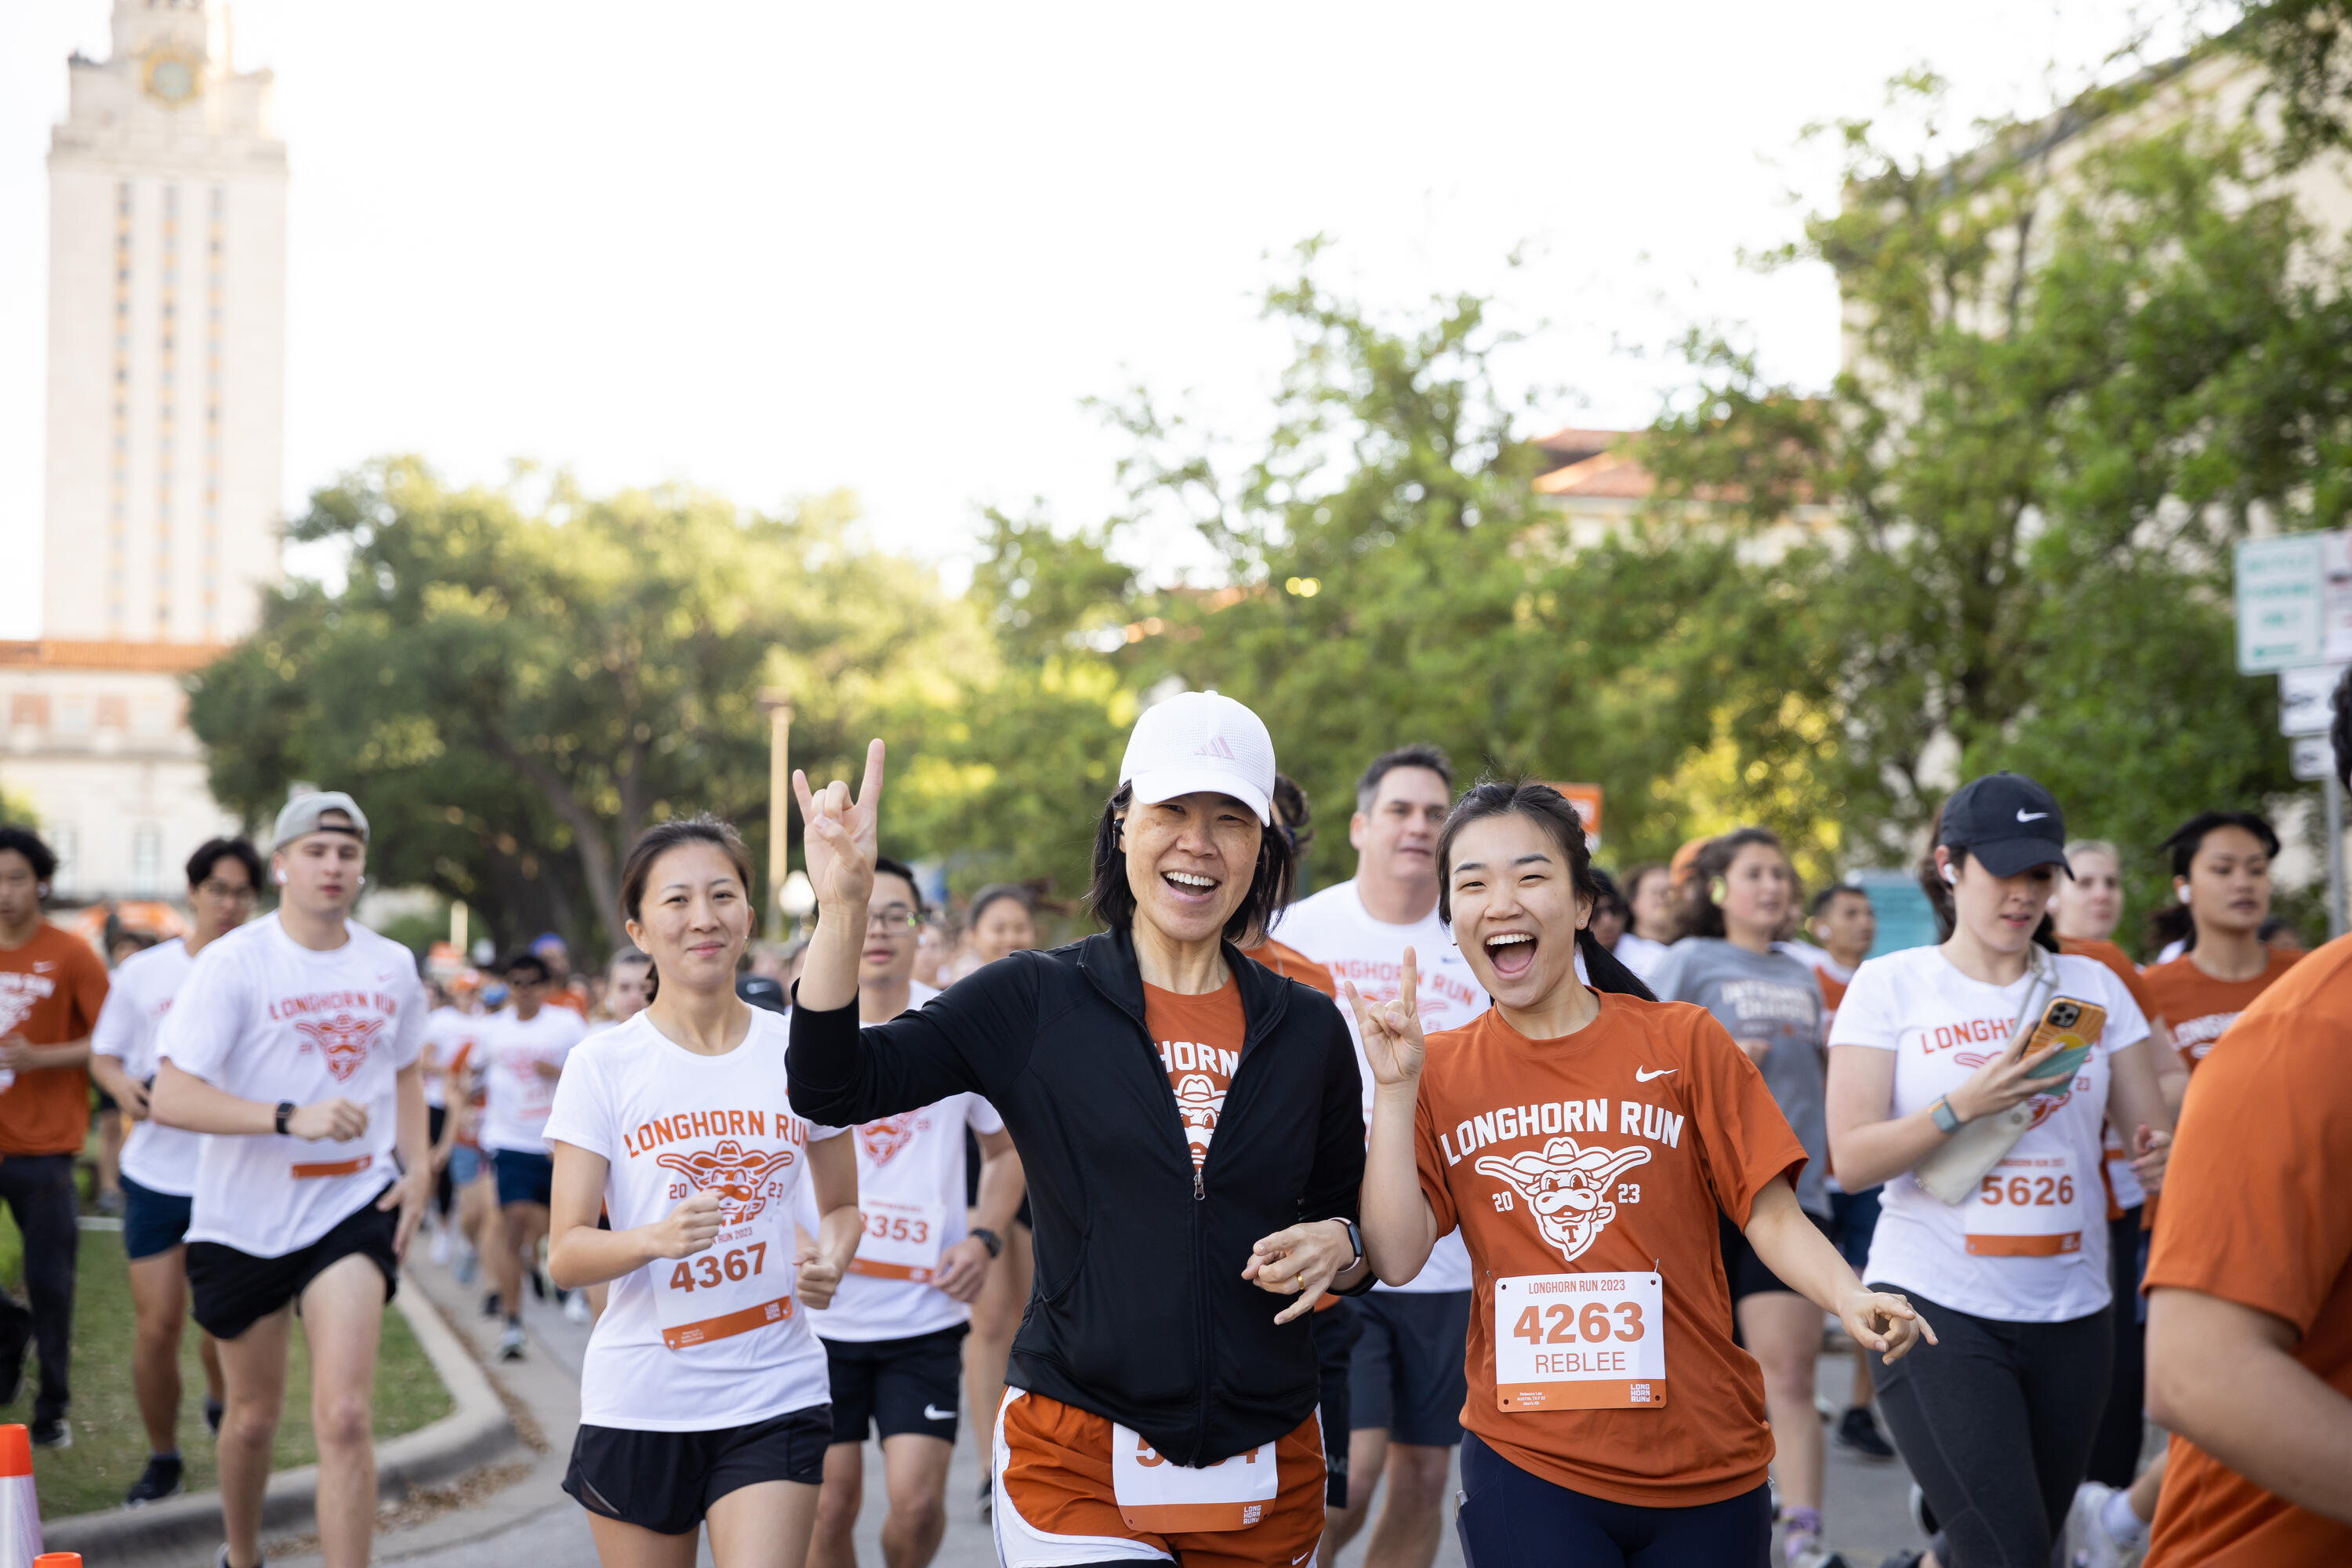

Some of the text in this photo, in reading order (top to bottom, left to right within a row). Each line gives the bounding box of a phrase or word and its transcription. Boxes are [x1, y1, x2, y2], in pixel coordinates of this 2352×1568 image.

[1432, 972, 1475, 1006] RUN
[1921, 1018, 2016, 1054] LONGH
[624, 1110, 764, 1158] LONGHORN
[1440, 1098, 1608, 1167] LONGHORN
[1620, 1100, 1685, 1149] RUN
[670, 1181, 784, 1200] 20 23
[1492, 1184, 1640, 1213] 20 23
[1980, 1174, 2074, 1206] 5626
[670, 1241, 767, 1293] 4367
[1528, 1279, 1625, 1294] LONGHORN RUN 2023
[1513, 1301, 1645, 1345] 4263
[1535, 1351, 1626, 1374] REBLEE
